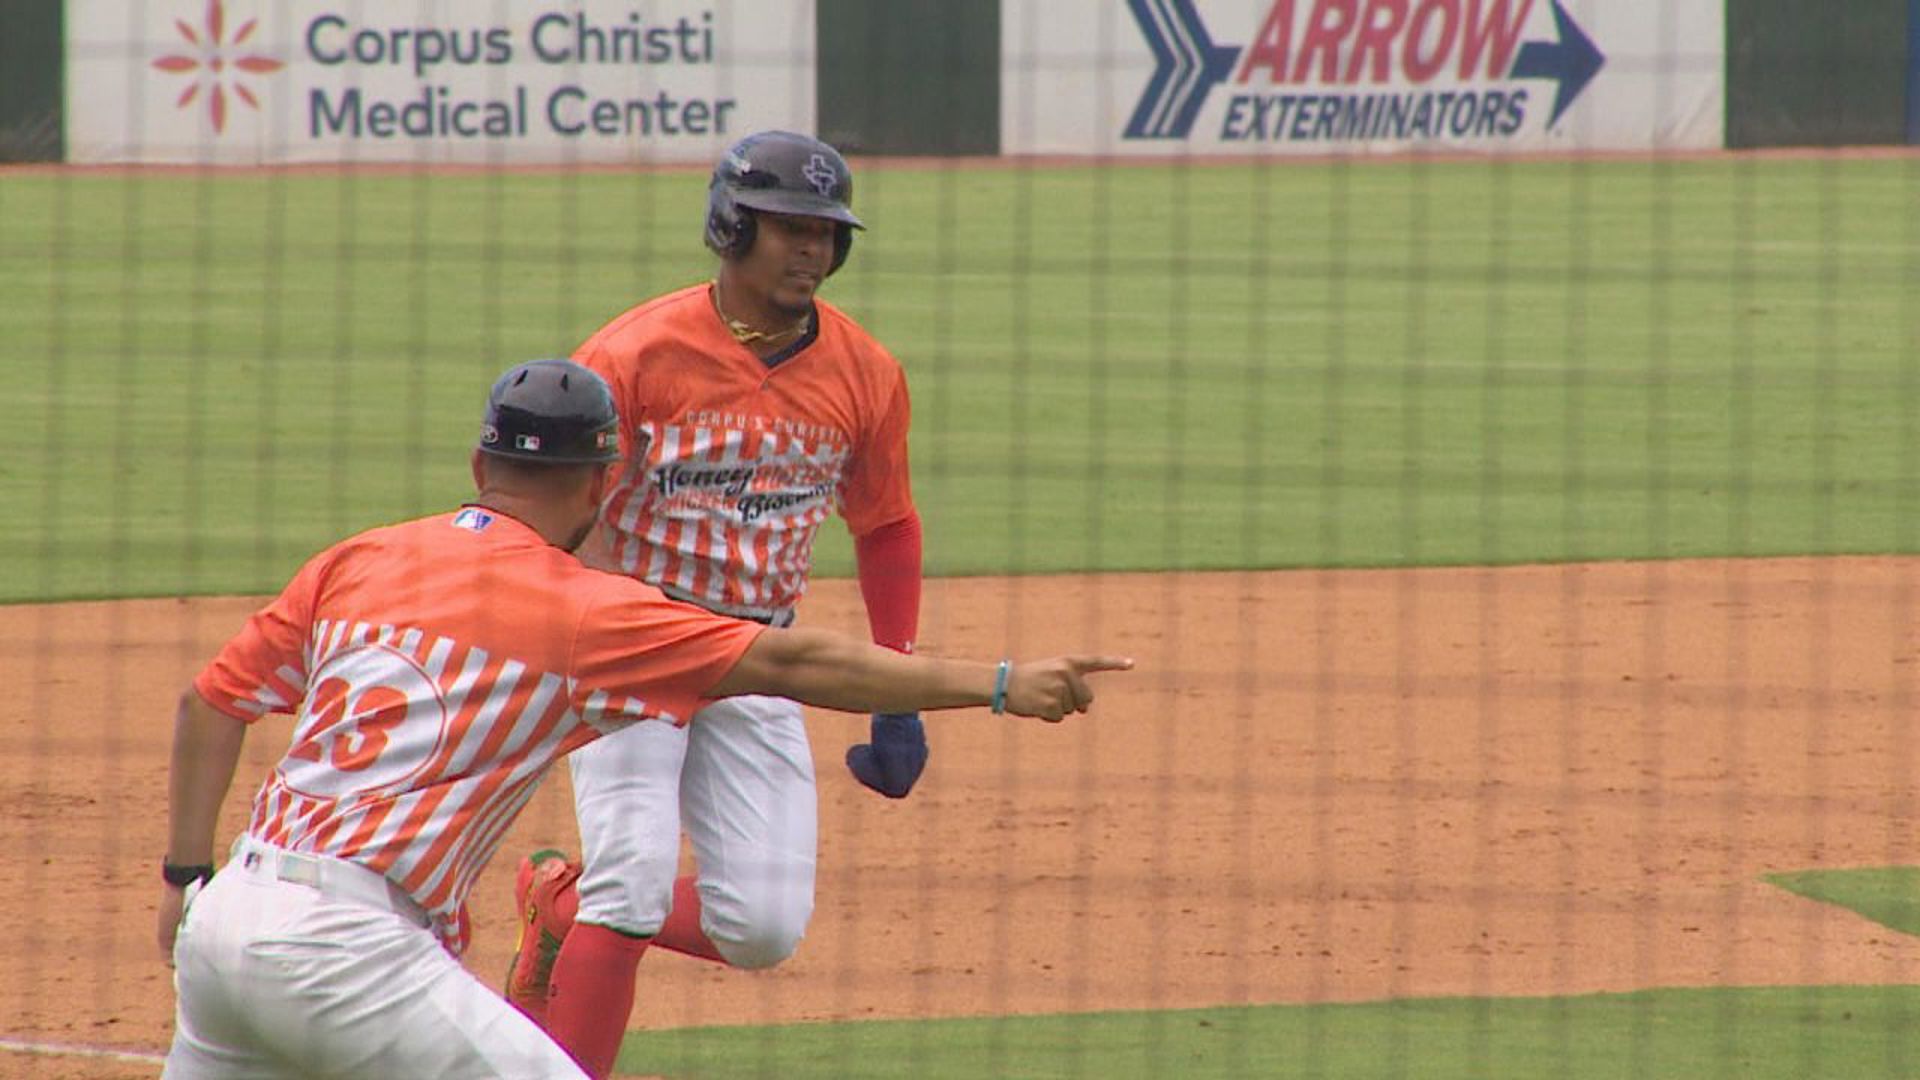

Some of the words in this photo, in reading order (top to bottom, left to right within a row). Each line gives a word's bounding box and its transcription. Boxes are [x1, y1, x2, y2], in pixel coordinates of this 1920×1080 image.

[306, 14, 512, 76] Corpus
[531, 12, 714, 65] Christi
[1236, 0, 1532, 86] ARROW
[309, 86, 528, 138] Medical
[546, 85, 736, 136] Center
[1219, 90, 1529, 141] EXTERMINATORS
[655, 460, 760, 496] Honey
[287, 676, 409, 772] 23
